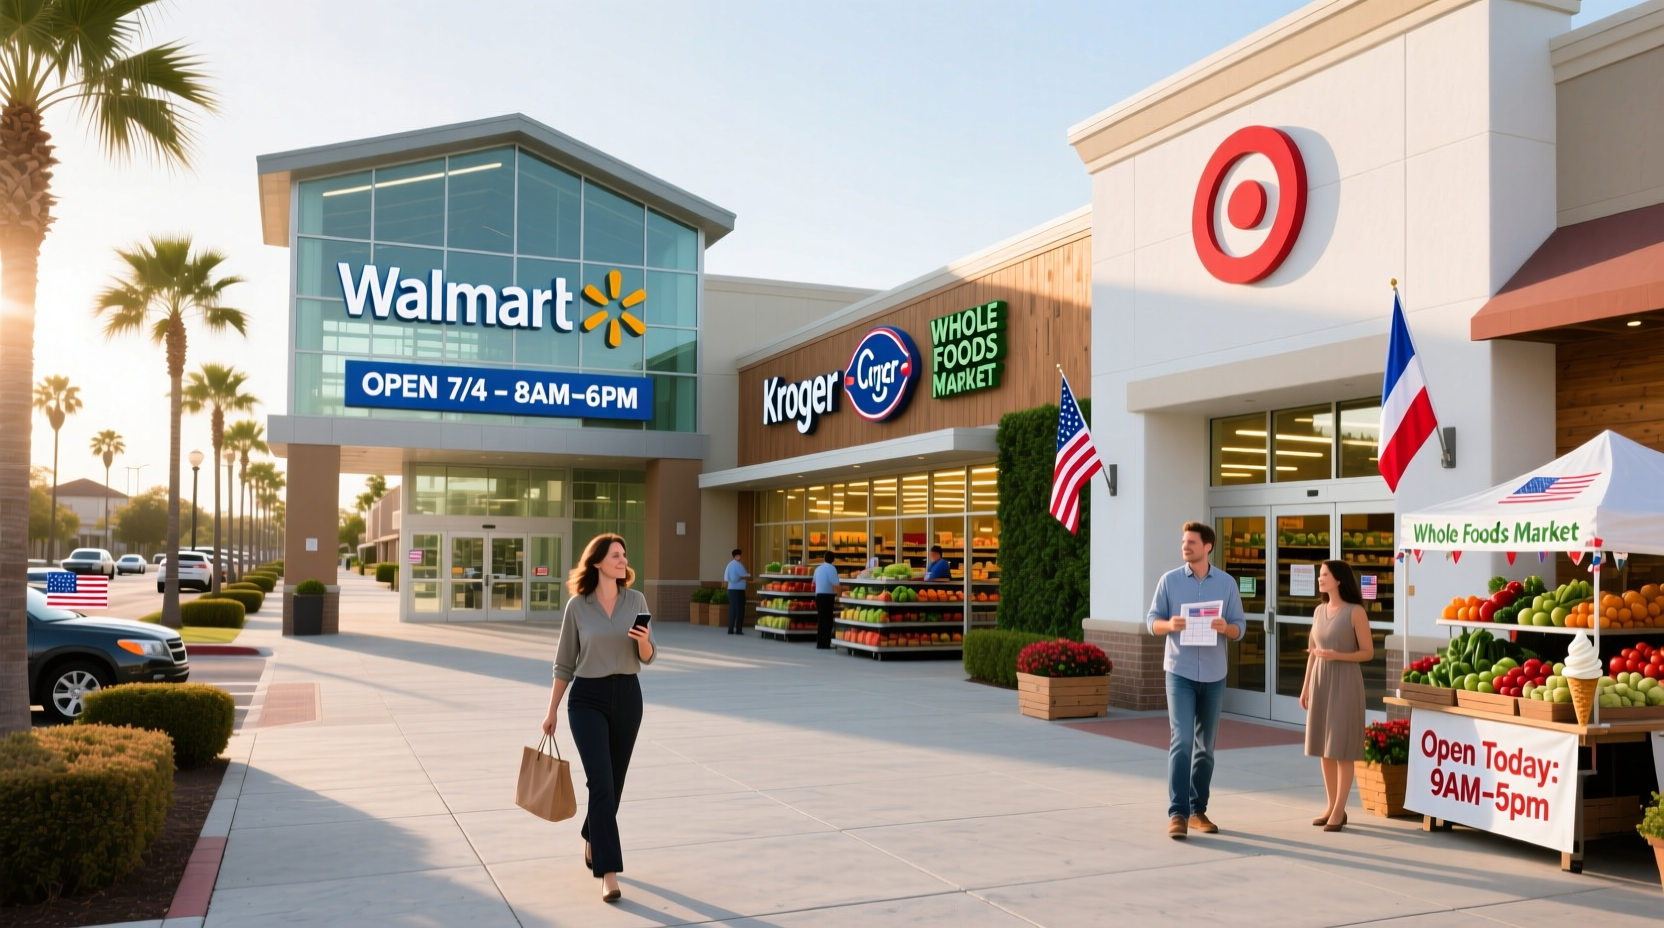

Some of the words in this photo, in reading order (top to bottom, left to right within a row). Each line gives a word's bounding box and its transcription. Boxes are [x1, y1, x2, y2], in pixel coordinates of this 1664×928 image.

[337, 262, 573, 331] Walmart
[930, 302, 998, 345] WHOLE
[933, 333, 998, 372] FOODS
[361, 371, 438, 399] OPEN
[447, 377, 488, 402] 7/4
[932, 363, 997, 399] MARKET
[763, 371, 839, 434] Kroger
[1413, 523, 1459, 544] Whole
[1462, 521, 1509, 543] Foods
[1513, 520, 1579, 543] Market
[1421, 729, 1476, 767] Open
[1482, 740, 1559, 788] Today:
